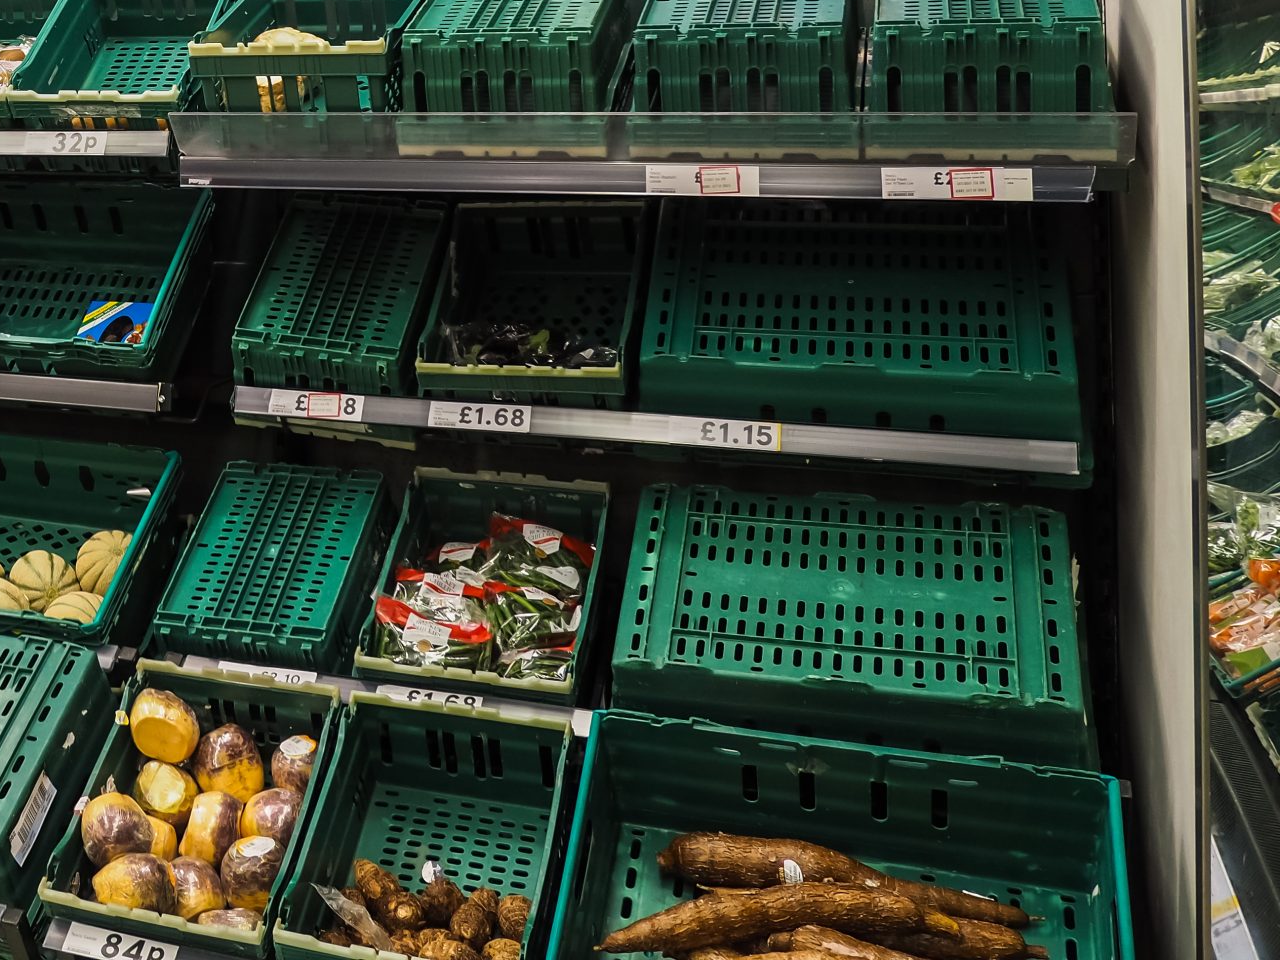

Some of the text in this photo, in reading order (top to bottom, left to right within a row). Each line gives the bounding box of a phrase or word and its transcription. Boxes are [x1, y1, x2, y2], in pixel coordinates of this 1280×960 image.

[51, 132, 98, 153] 32p
[458, 406, 525, 428] £1.68
[700, 421, 773, 446] £1.15
